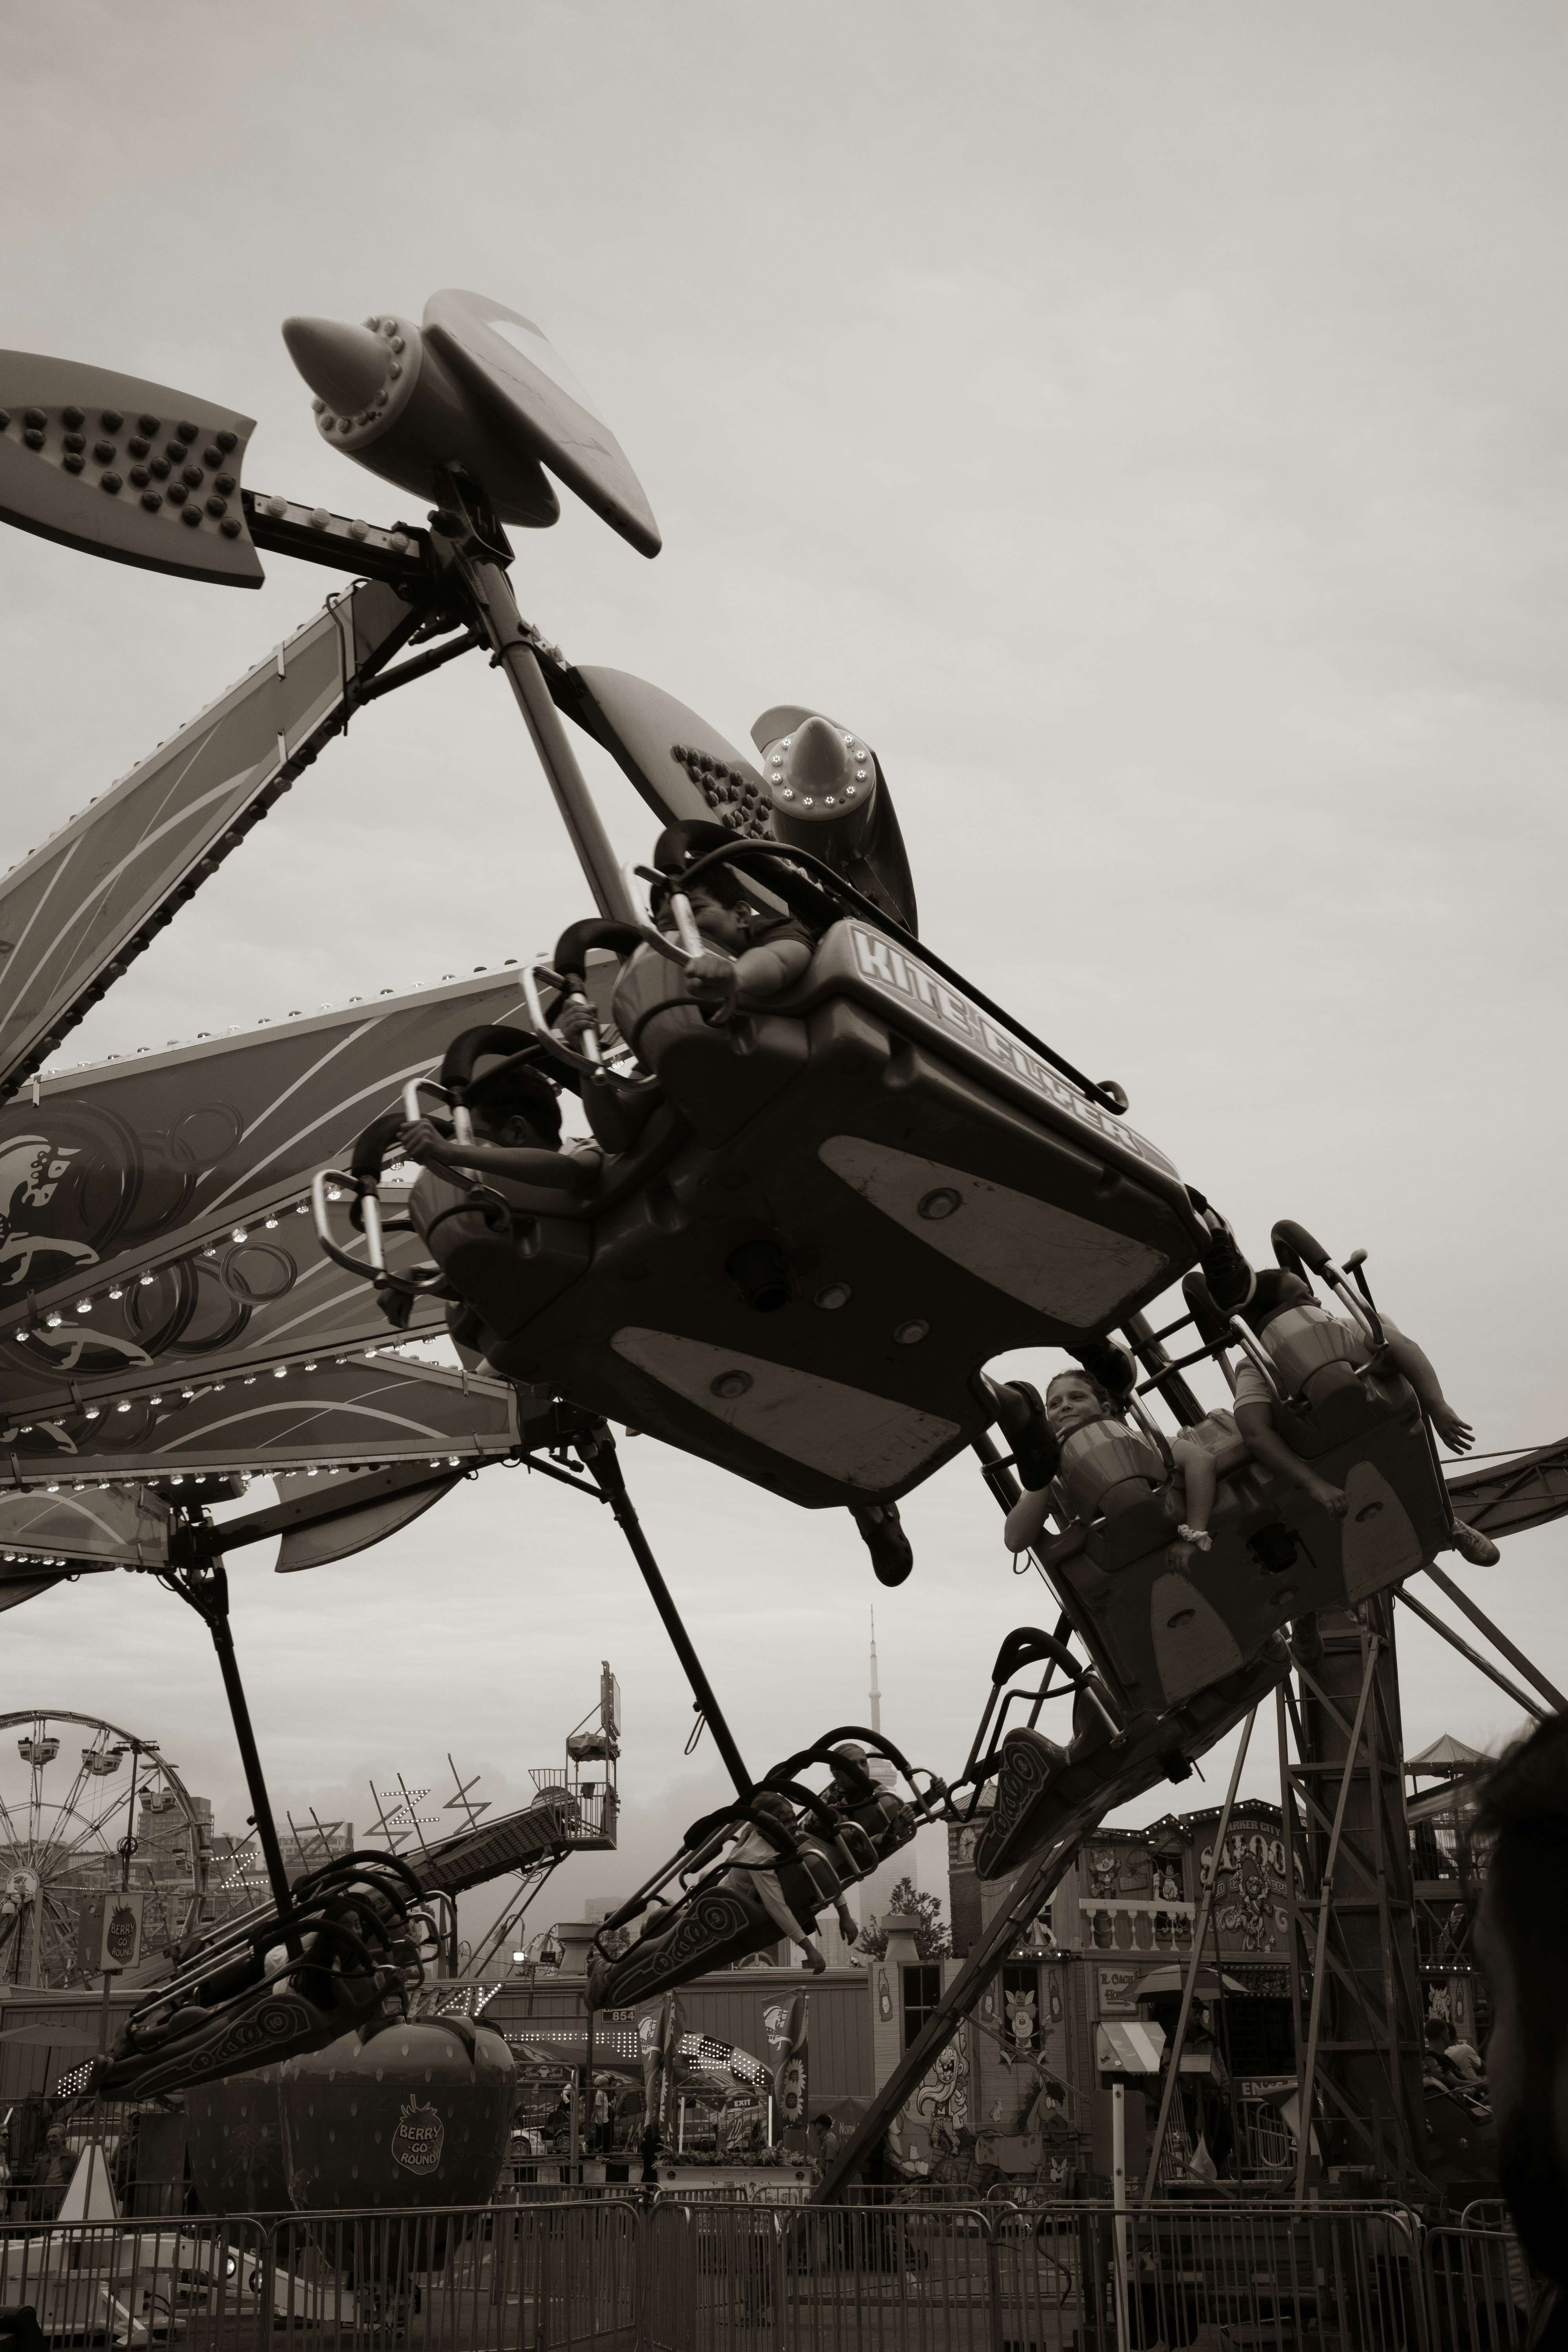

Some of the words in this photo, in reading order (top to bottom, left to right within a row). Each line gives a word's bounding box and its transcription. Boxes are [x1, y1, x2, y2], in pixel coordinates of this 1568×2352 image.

[853, 929, 970, 1033] KITE
[981, 1020, 1141, 1153] FLYER
[1018, 1759, 1027, 1771] 8
[1227, 1820, 1259, 1832] ARKER
[1260, 1821, 1281, 1837] CITY
[711, 1912, 720, 1923] 9
[111, 1921, 136, 1935] BERRY
[112, 1947, 132, 1957] ROUND
[269, 2016, 282, 2029] 10
[612, 2011, 635, 2021] 854
[734, 2099, 751, 2107] EXIT
[399, 2124, 442, 2141] BERRY
[839, 2122, 855, 2135] NORTH
[400, 2152, 437, 2165] ROUND
